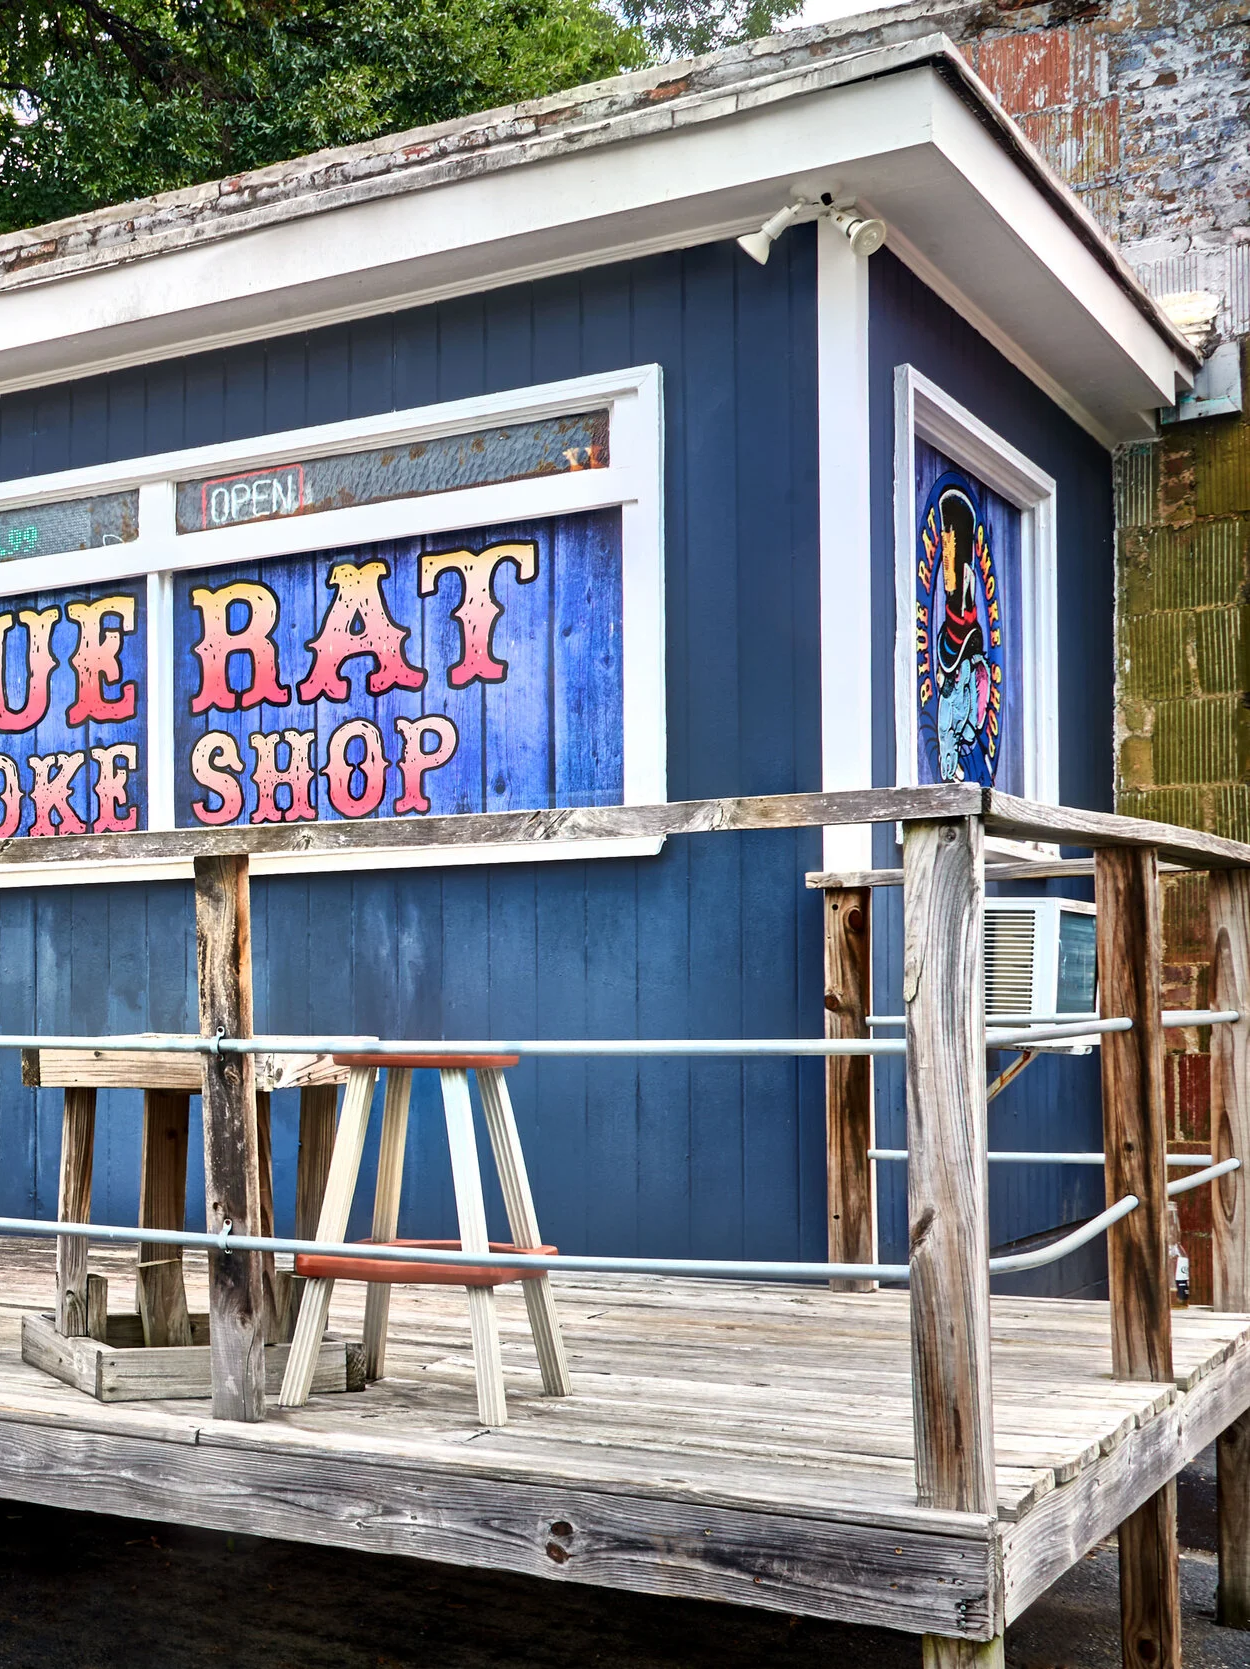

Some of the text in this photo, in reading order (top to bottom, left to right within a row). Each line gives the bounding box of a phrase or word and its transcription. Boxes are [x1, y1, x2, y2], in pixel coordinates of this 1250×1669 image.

[210, 474, 293, 524] OPEN
[188, 539, 540, 716] RAT
[915, 506, 1002, 759] BLUE RAT SMOKE SHOP
[189, 713, 460, 827] SHOP
